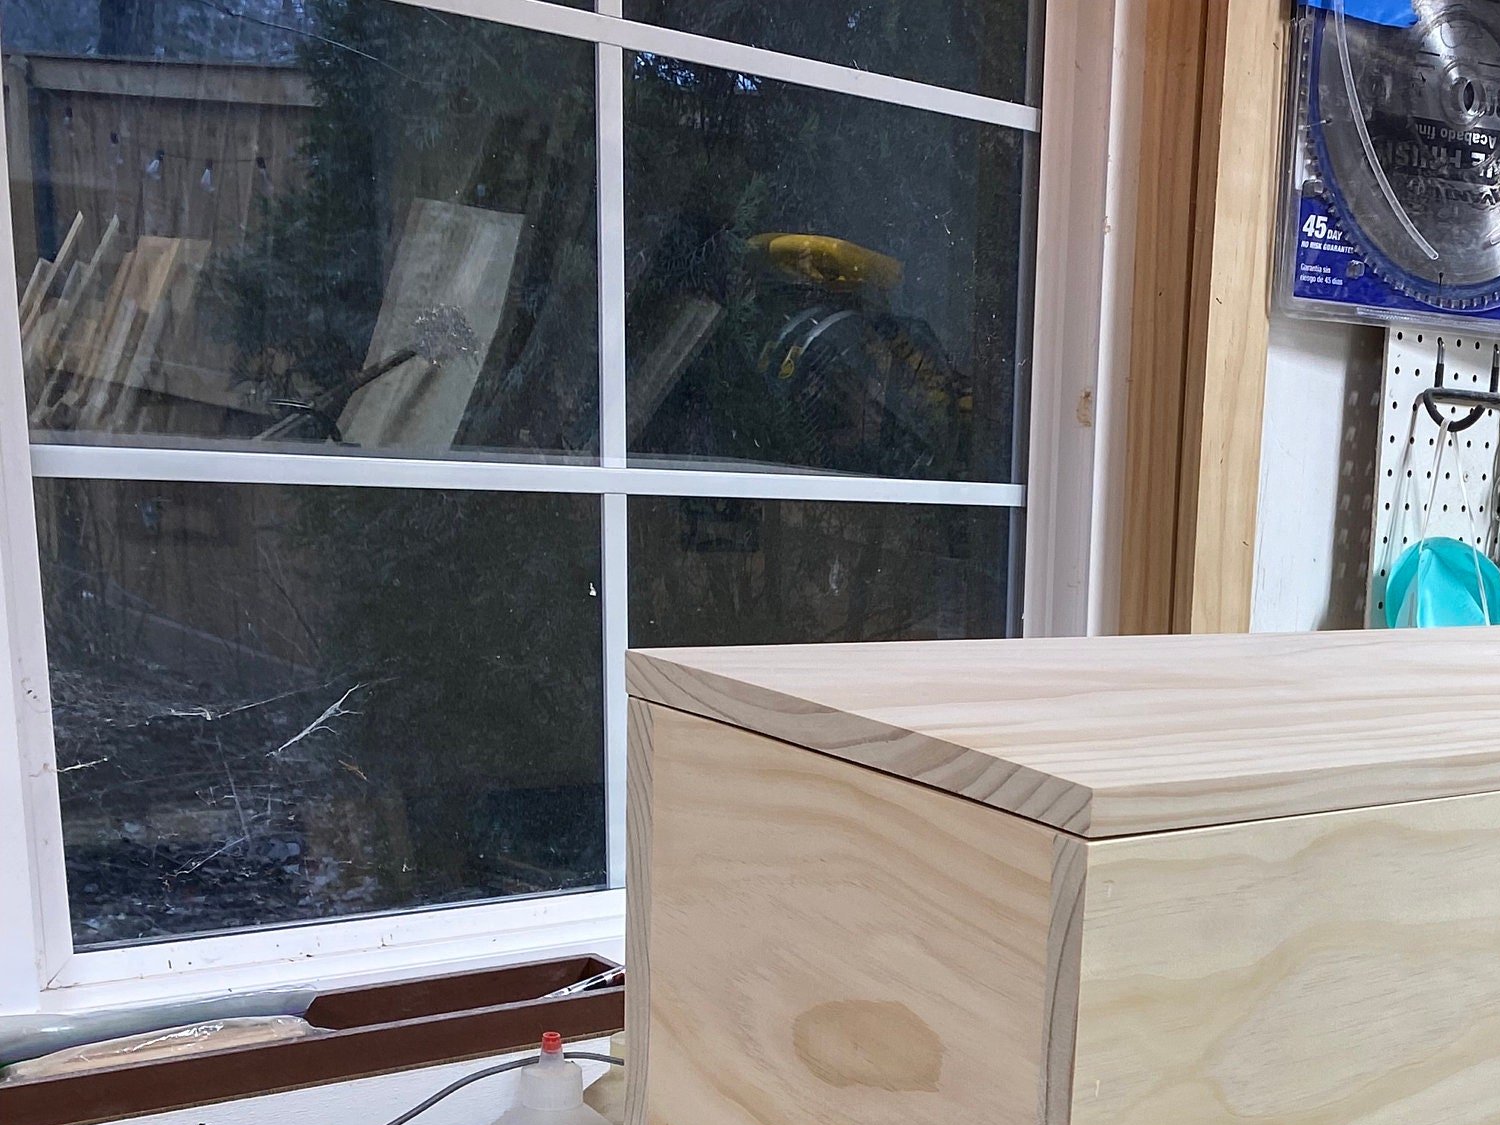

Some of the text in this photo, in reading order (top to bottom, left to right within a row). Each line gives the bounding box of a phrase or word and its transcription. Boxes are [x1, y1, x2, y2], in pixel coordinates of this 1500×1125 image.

[1441, 127, 1496, 149] Acabado
[1302, 214, 1343, 241] 45 DAY
